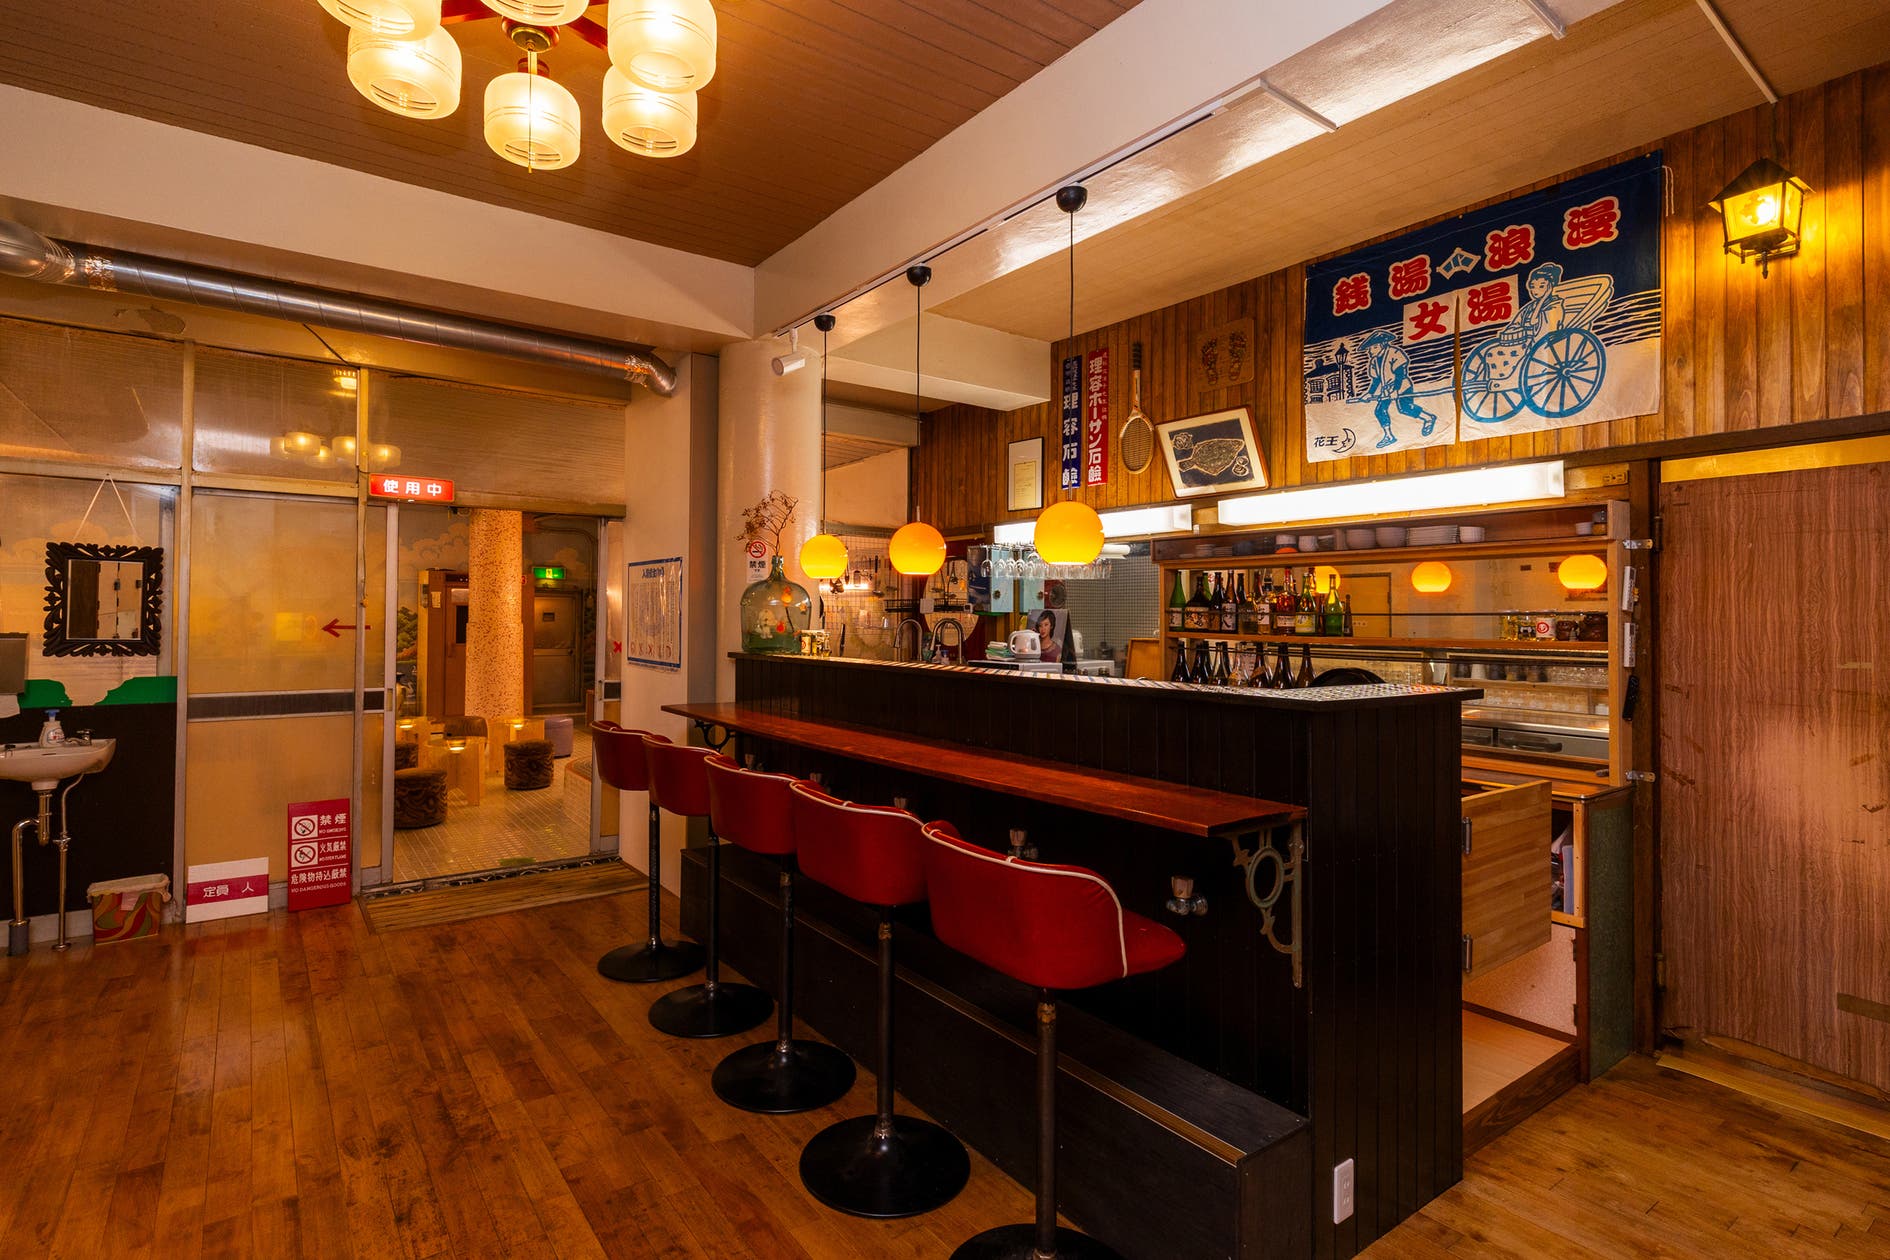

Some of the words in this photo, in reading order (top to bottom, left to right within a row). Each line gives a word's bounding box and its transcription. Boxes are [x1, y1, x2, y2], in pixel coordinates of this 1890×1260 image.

[1408, 281, 1512, 341] 女湯
[1313, 435, 1339, 448] 花王
[383, 479, 442, 497] 使用中
[749, 560, 766, 569] 禁煙
[319, 813, 347, 826] 禁煙
[319, 840, 347, 854] 火気厳禁
[291, 868, 347, 885] 危険物持込厳禁
[203, 885, 229, 898] 定員
[241, 881, 255, 893] 人
